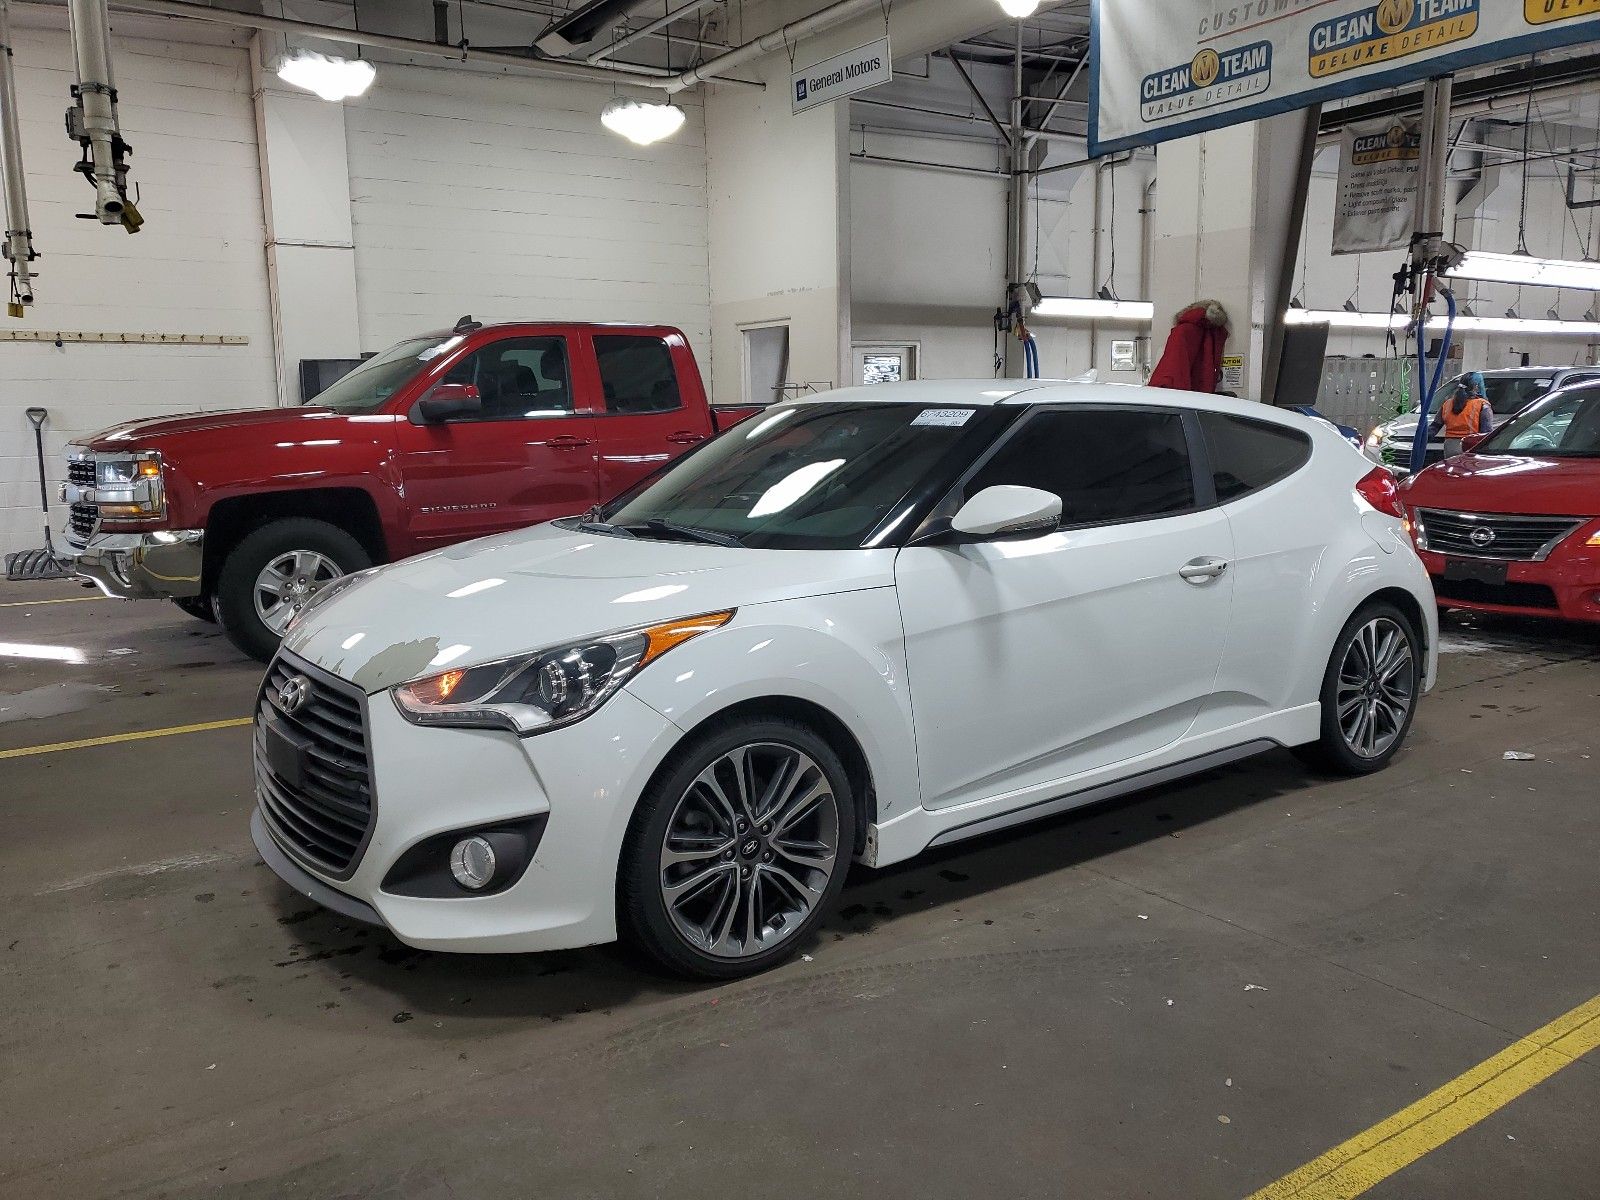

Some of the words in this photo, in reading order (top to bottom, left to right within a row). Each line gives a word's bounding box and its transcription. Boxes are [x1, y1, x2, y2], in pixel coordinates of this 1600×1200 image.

[1198, 0, 1302, 36] CUSTOM
[1313, 12, 1374, 51] CLEAN
[1318, 42, 1390, 71] DELUXE
[1401, 20, 1466, 50] DETAIL
[809, 69, 843, 92] General
[845, 57, 881, 80] Motors
[1143, 68, 1190, 99] CLEAN
[1221, 46, 1267, 78] TEAM
[1148, 96, 1195, 116] VALUE
[1205, 78, 1261, 102] DETAIL
[1355, 135, 1387, 152] CLEAN
